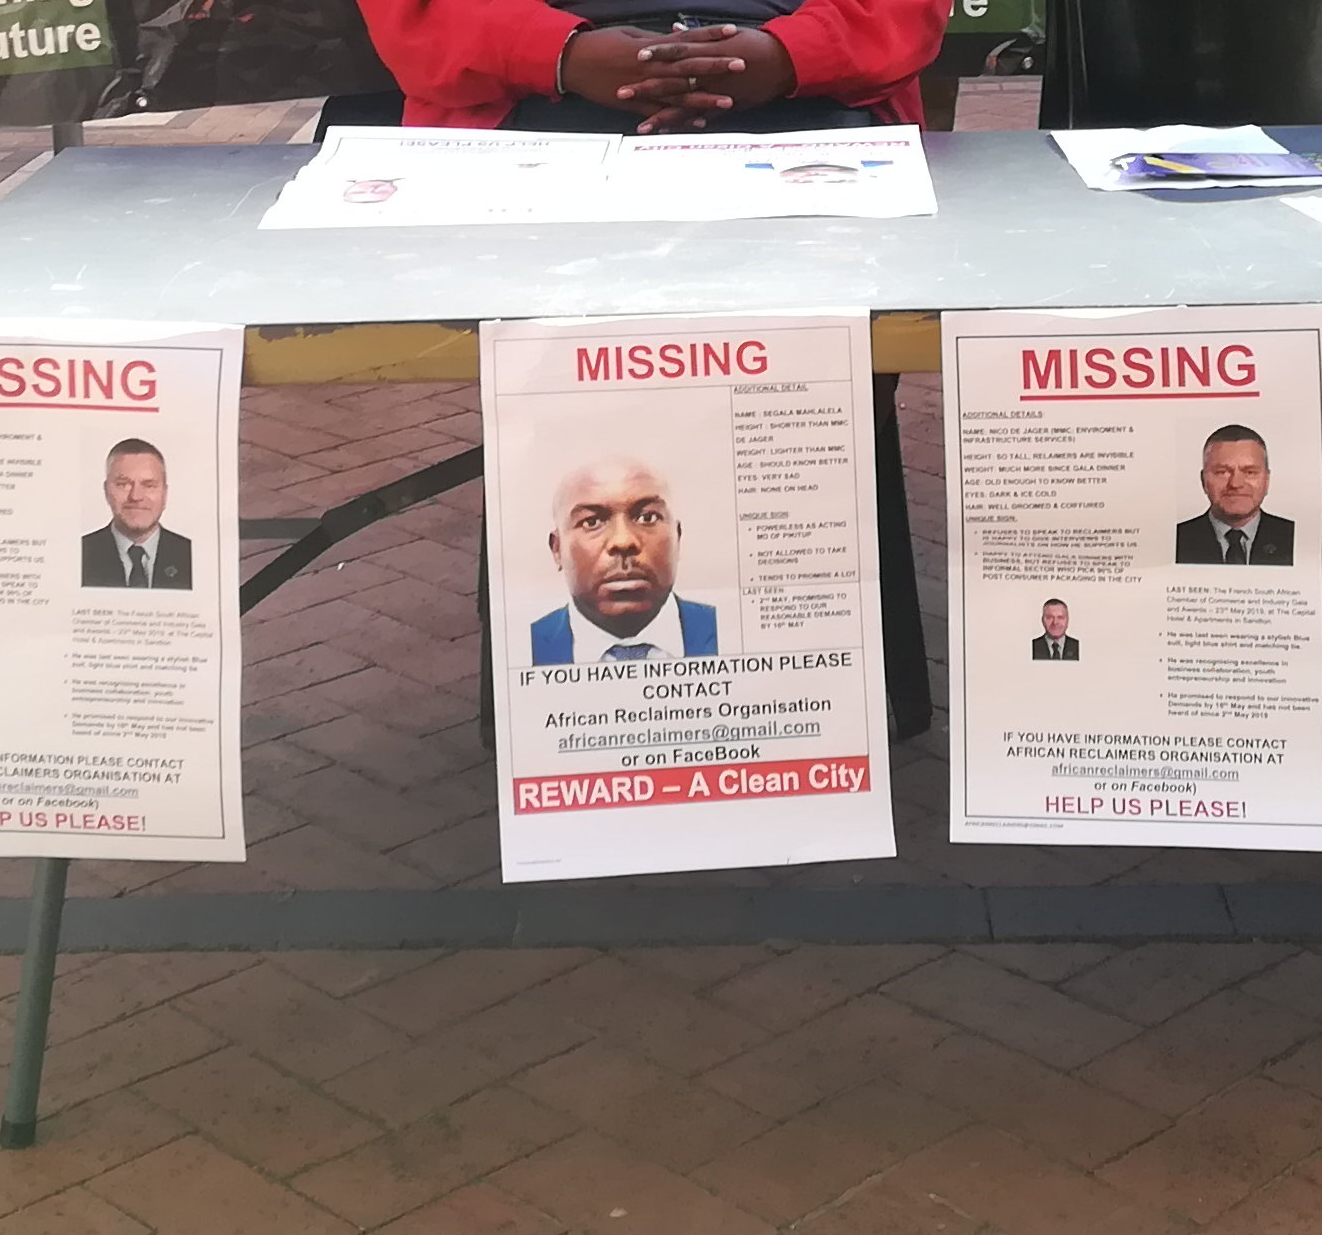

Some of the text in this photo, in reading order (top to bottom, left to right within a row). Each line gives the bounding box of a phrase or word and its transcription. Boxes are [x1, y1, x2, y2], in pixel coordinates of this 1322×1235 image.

[577, 341, 767, 381] MISSING
[1022, 345, 1255, 389] MISSING
[521, 652, 851, 686] IF YOU HAVE INFORMATION PLEASE
[643, 681, 732, 699] CONTACT
[546, 698, 831, 728] African Reclaimers Organisation
[558, 721, 821, 750] africanreclaimers@gmail.com
[1004, 732, 1286, 749] IF YOU HAVE INFORMATION PLEASE CONTACT
[77, 756, 122, 766] PLEASE
[127, 758, 184, 769] CONTACT
[622, 744, 760, 766] or on FaceBook
[1007, 747, 1283, 764] AFRICAN RECLAIMERS ORGANISATION AT
[64, 769, 160, 782] ORGANISATION
[165, 773, 180, 783] AT
[1051, 764, 1239, 780] africanreclaimers@gmail.com
[519, 776, 654, 809] REWARD
[688, 772, 710, 797] A
[719, 769, 799, 794] Clean
[809, 763, 865, 793] City
[1112, 783, 1127, 791] on
[1131, 781, 1196, 796] Facebook)
[1046, 796, 1246, 818] HELP US PLEASE!
[19, 812, 47, 827] US
[55, 813, 145, 831] PLEASE!
